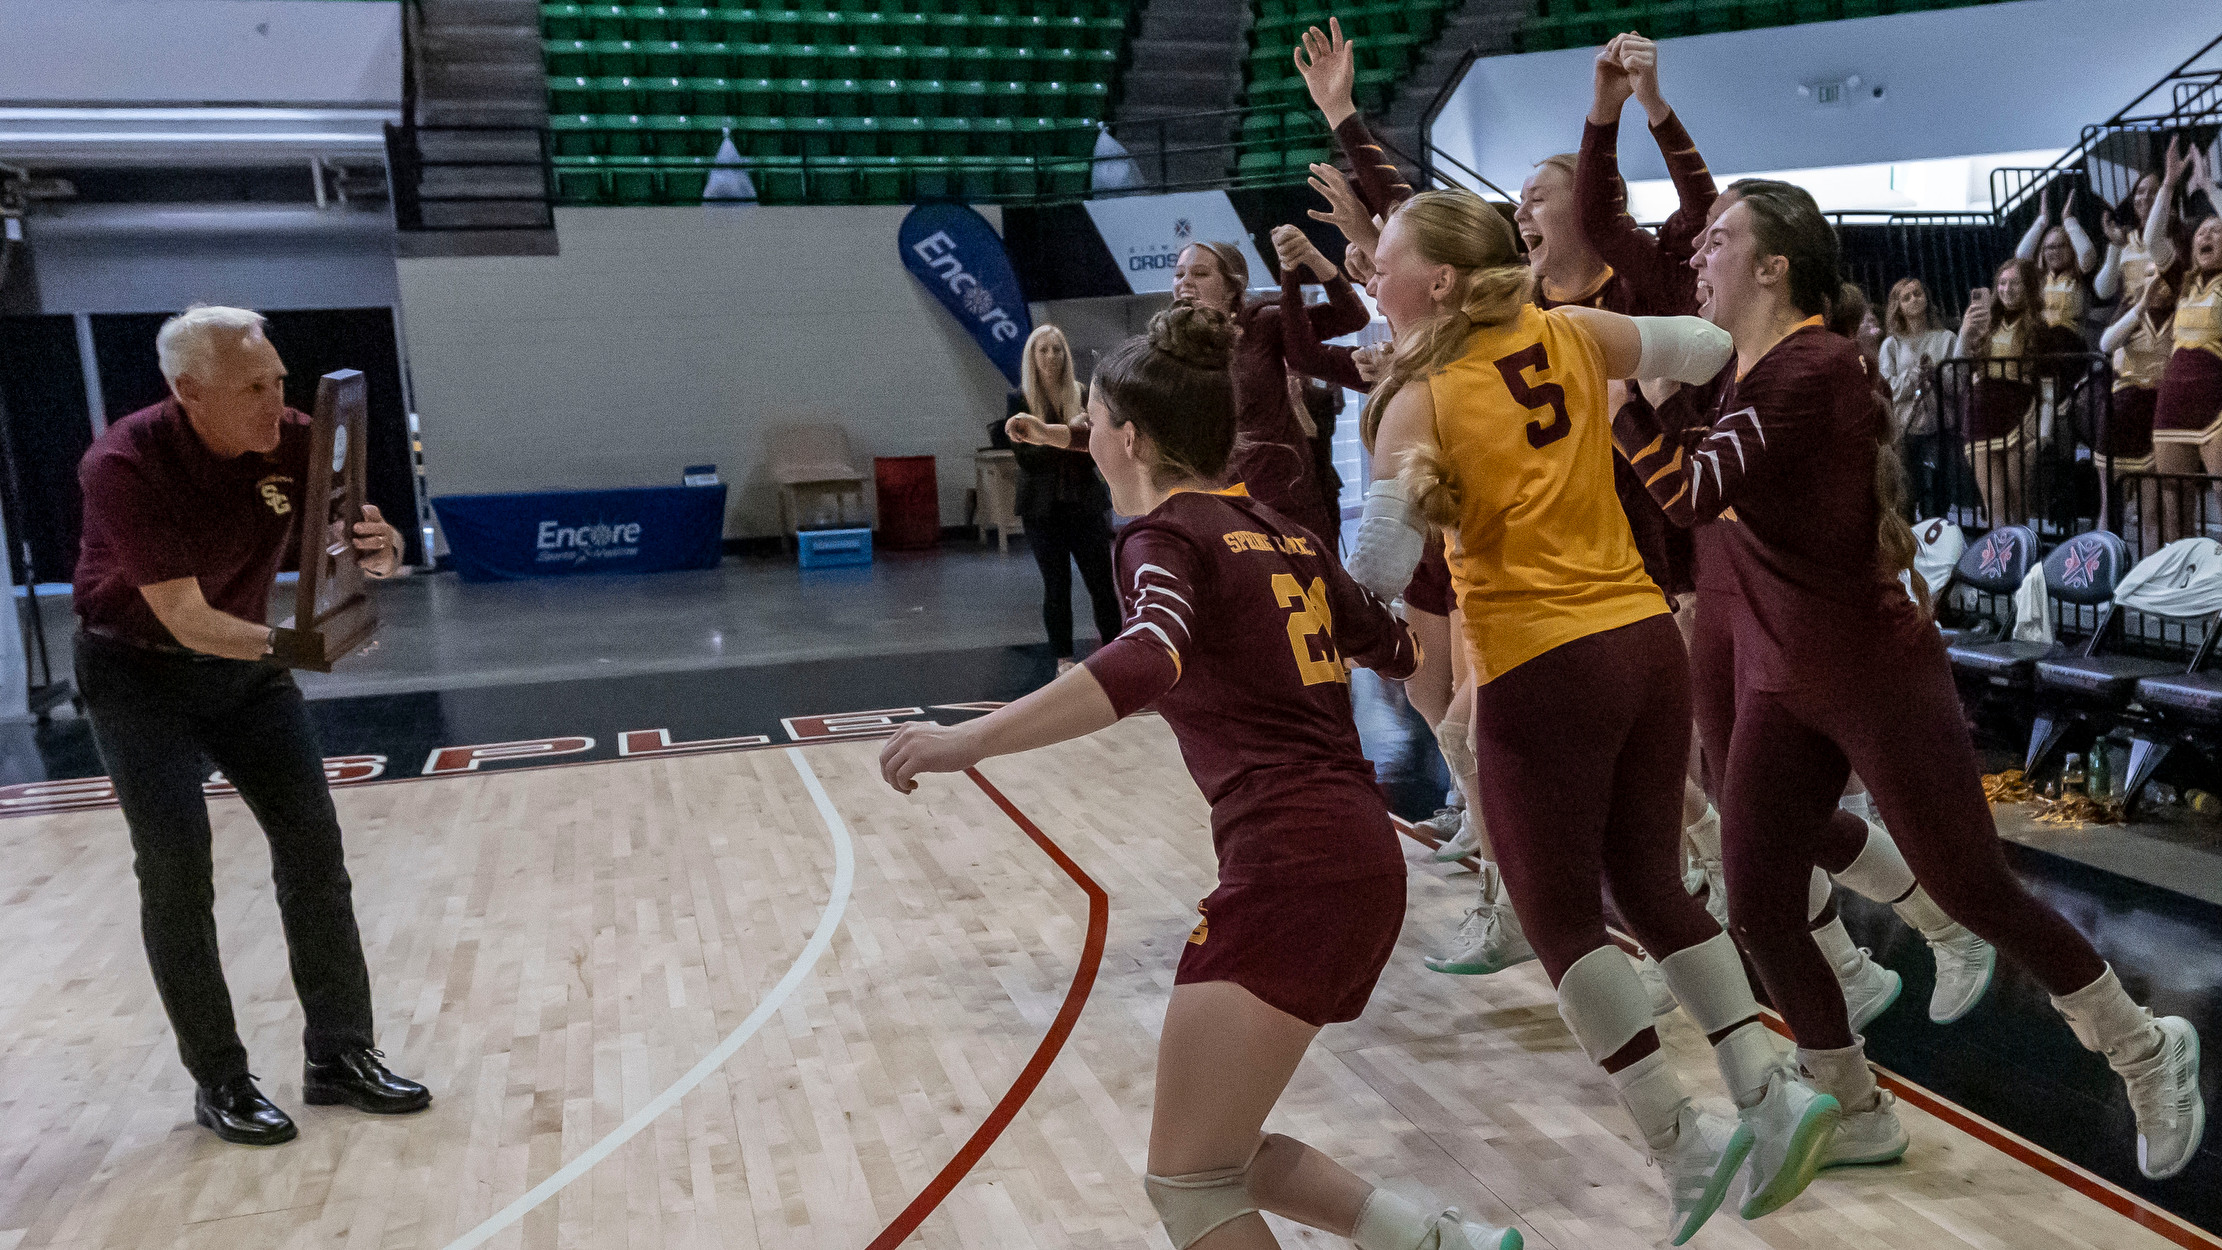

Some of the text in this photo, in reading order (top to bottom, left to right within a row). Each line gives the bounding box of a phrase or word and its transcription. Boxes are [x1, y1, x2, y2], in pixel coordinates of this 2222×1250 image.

[913, 230, 1018, 342] Encore
[1129, 253, 1178, 271] CROS
[1492, 341, 1572, 450] 5
[537, 520, 641, 549] Encore
